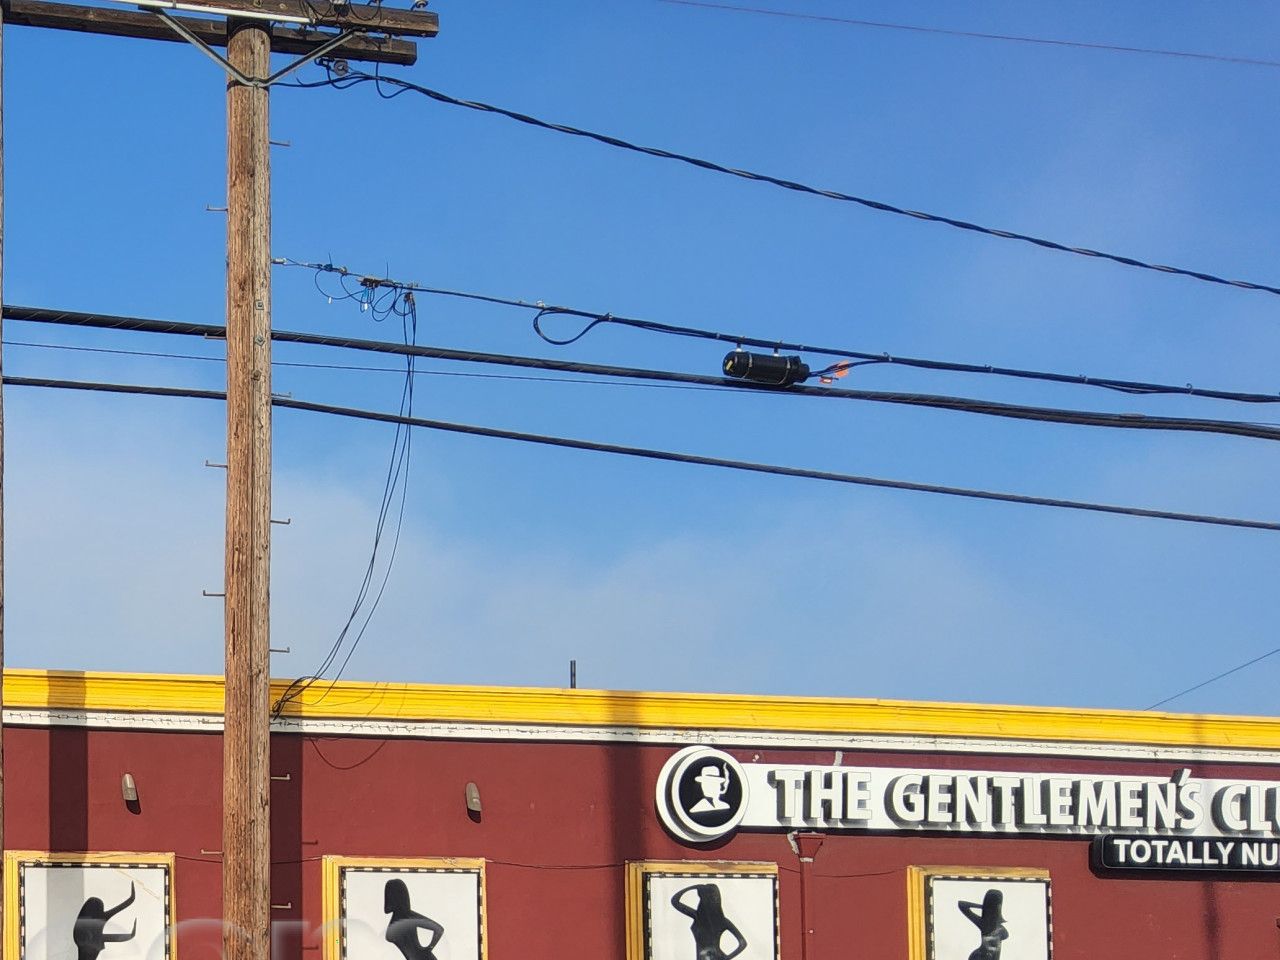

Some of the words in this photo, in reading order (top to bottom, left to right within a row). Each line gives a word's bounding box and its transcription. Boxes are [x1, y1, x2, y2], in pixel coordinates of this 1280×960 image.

[769, 769, 872, 823] THE
[887, 768, 1205, 832] GENTLEMEN'S
[1217, 784, 1280, 832] CL
[1114, 838, 1235, 865] TOTALLY
